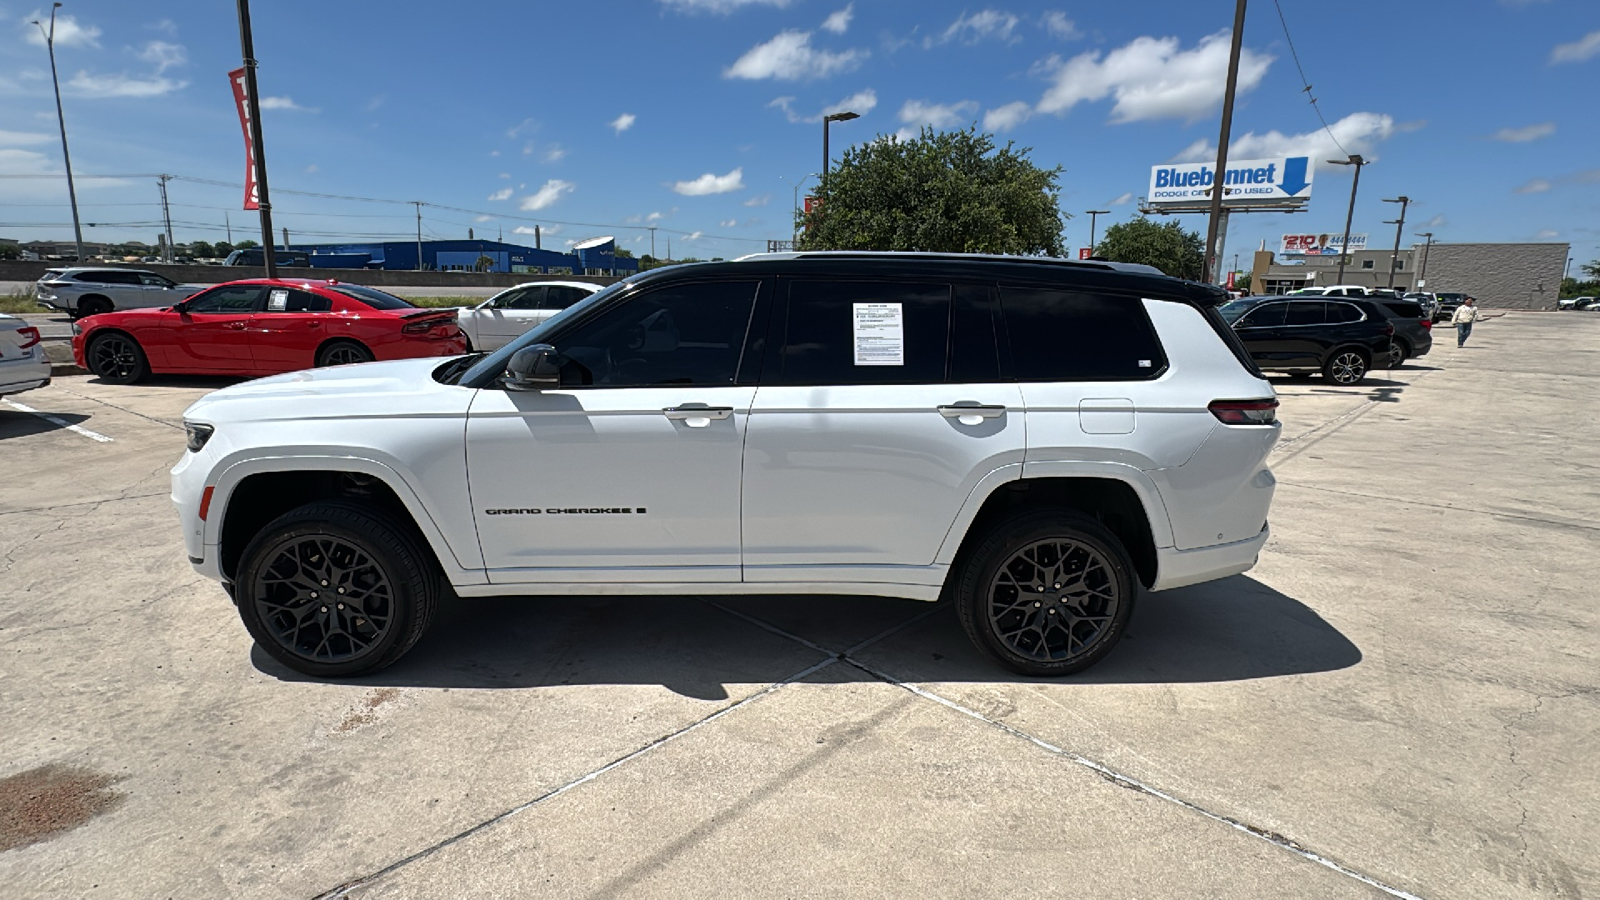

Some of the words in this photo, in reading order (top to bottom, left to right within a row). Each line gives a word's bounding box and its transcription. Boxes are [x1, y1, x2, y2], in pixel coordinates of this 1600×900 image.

[1155, 163, 1276, 188] Bluebnnet
[1155, 190, 1189, 198] DODGE
[1244, 187, 1274, 195] USED
